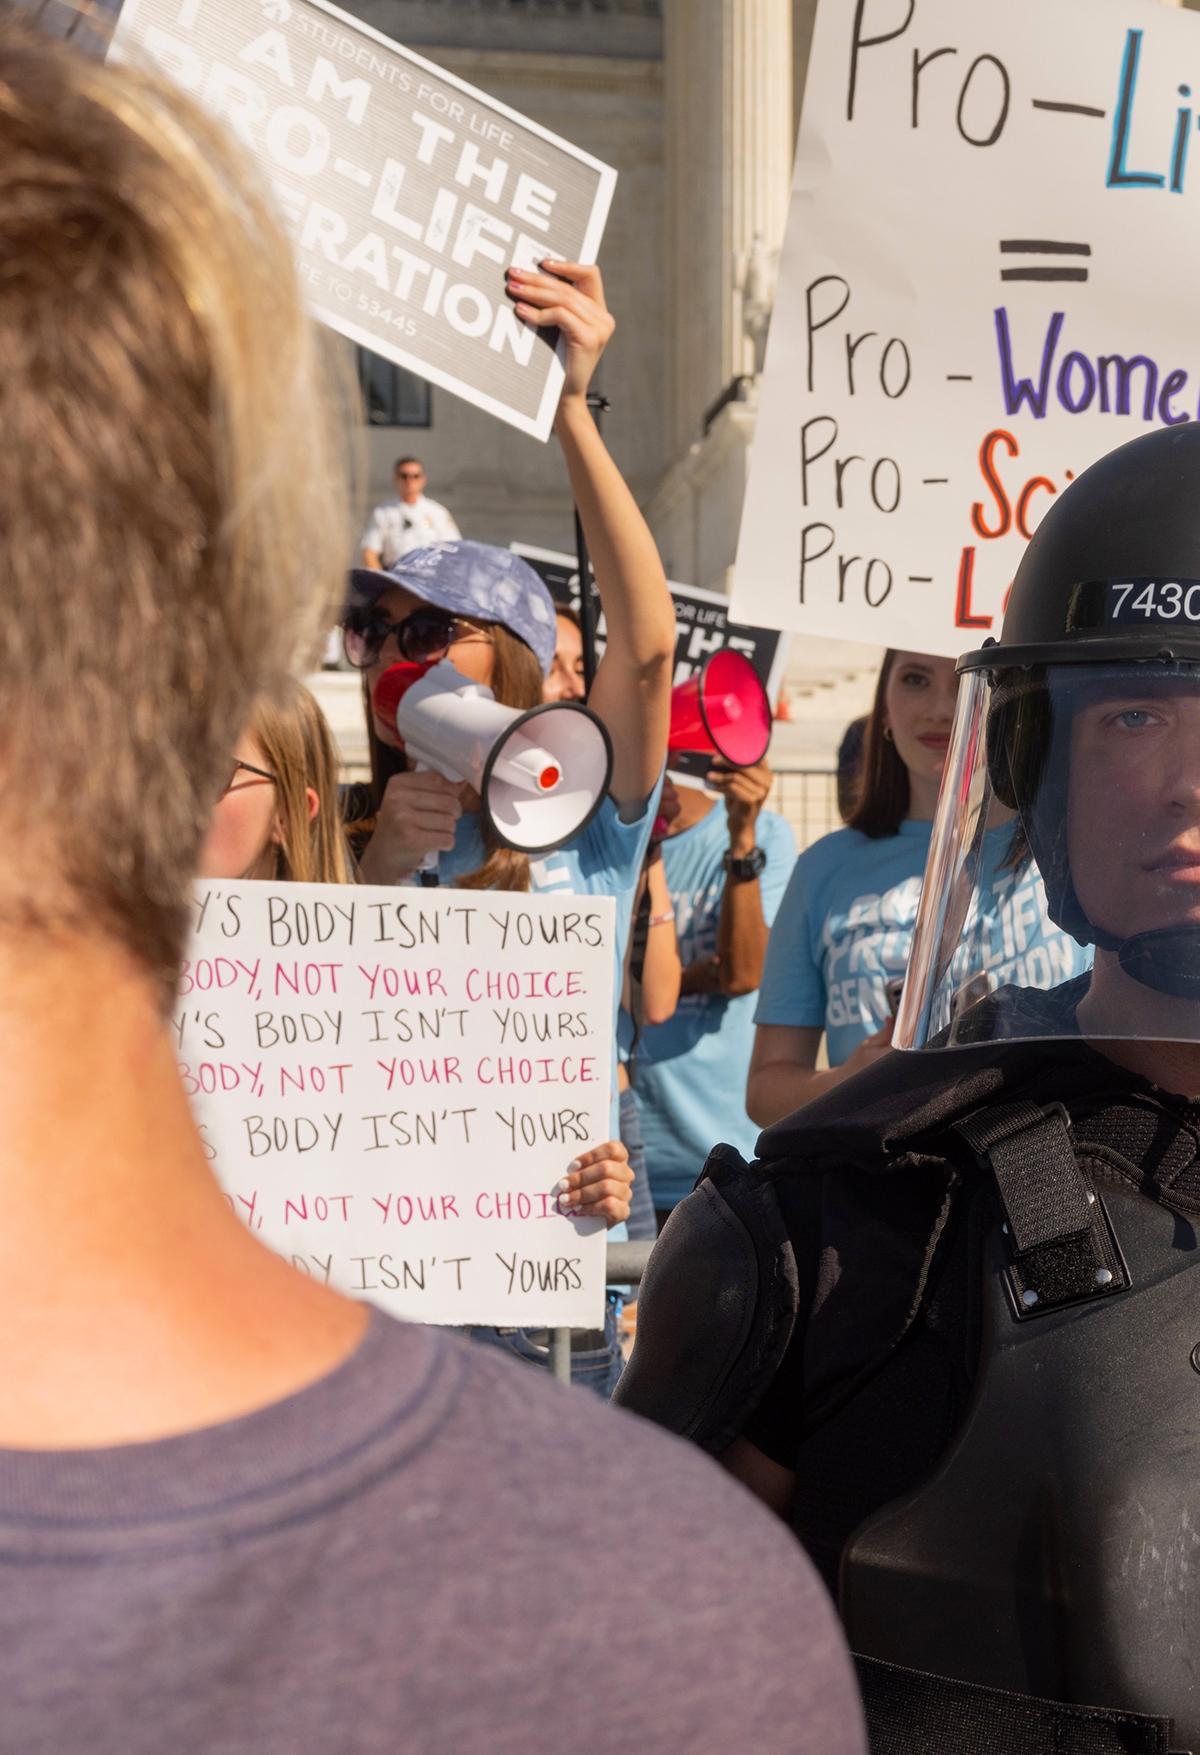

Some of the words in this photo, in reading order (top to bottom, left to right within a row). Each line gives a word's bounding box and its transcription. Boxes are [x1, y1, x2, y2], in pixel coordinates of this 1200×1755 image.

[297, 14, 412, 93] STUDENTS
[416, 84, 465, 124] FOR
[468, 113, 515, 151] LIFE
[238, 27, 371, 125] AM
[411, 110, 557, 232] THE
[357, 293, 417, 337] 53445
[267, 896, 355, 946] BODY
[368, 903, 477, 949] ISN'T
[274, 961, 344, 996] NOT
[358, 963, 448, 1000] YOUR
[255, 1010, 342, 1049] BODY
[361, 1008, 471, 1043] ISN'T
[279, 1063, 354, 1097] NOT
[377, 1056, 463, 1091] YOUR
[242, 1112, 343, 1157] BODY
[361, 1107, 478, 1153] ISN'T
[285, 1194, 353, 1226] NOT
[371, 1193, 460, 1226] YOUR
[350, 1256, 472, 1292] ISN'T
